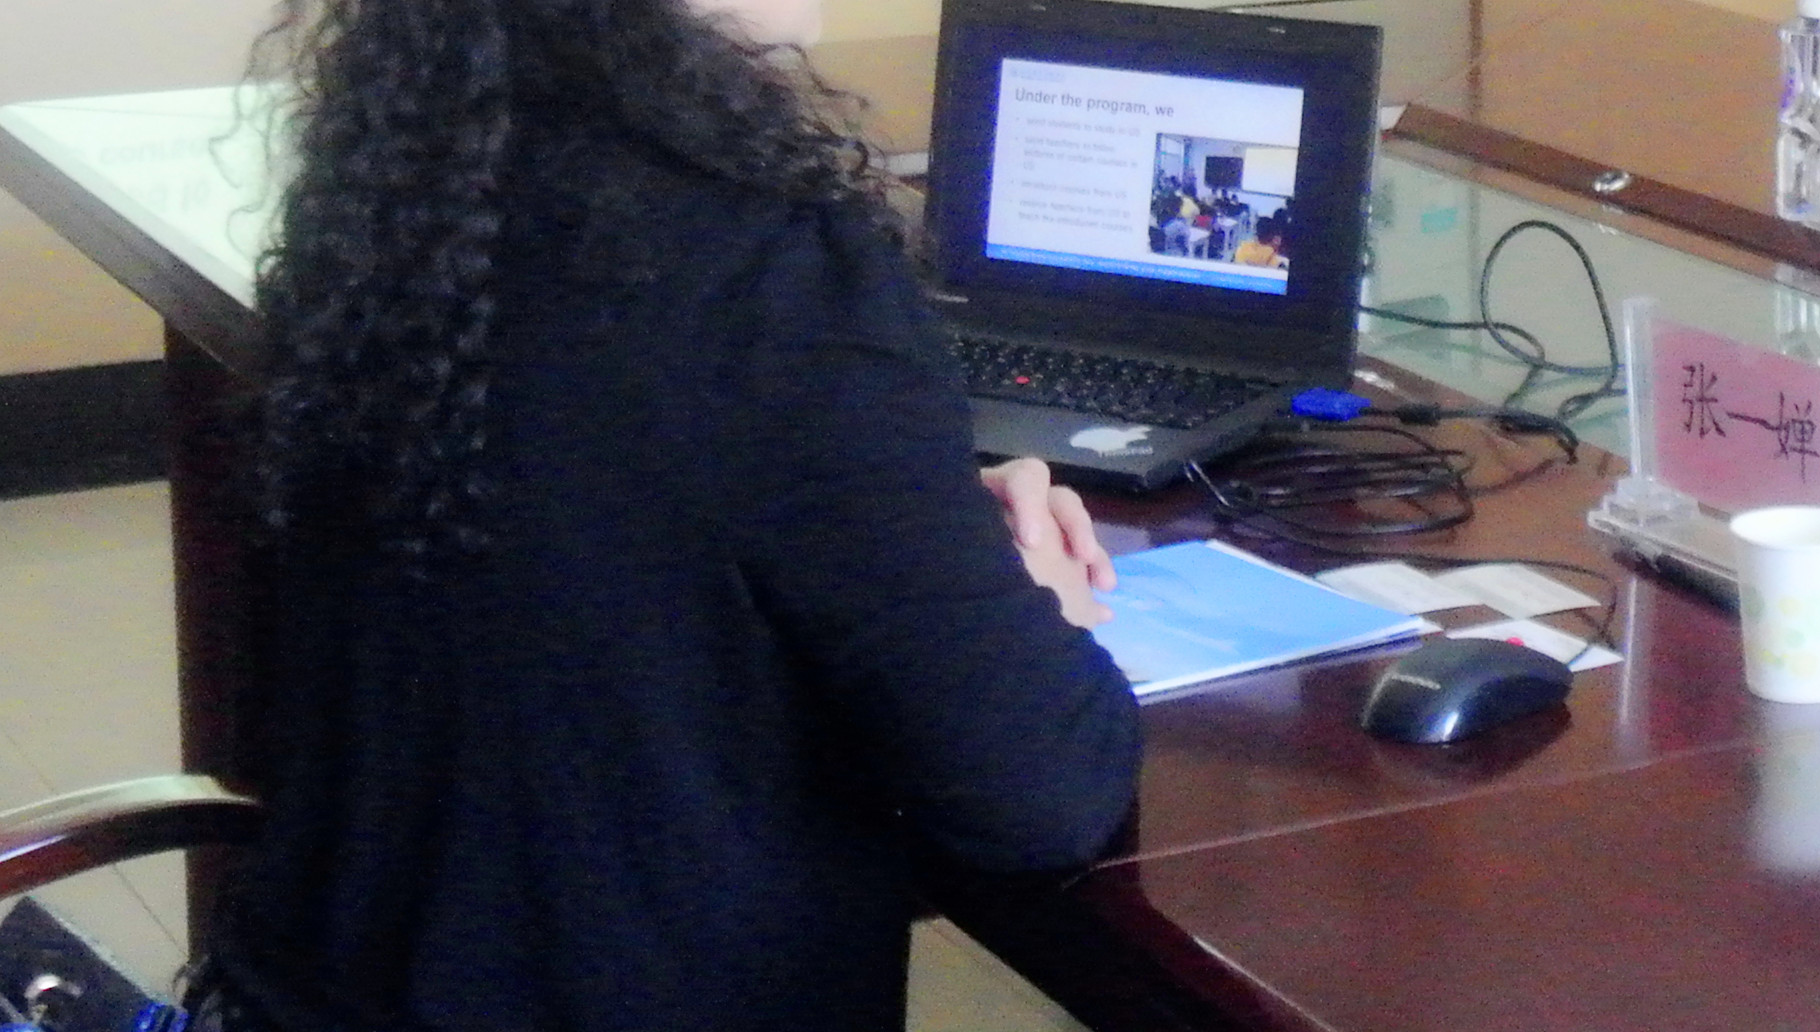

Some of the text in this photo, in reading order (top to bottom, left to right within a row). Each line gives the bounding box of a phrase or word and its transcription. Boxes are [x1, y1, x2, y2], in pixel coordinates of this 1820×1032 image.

[1015, 87, 1175, 118] Under the program, we
[1681, 362, 1820, 484] 张一婵
